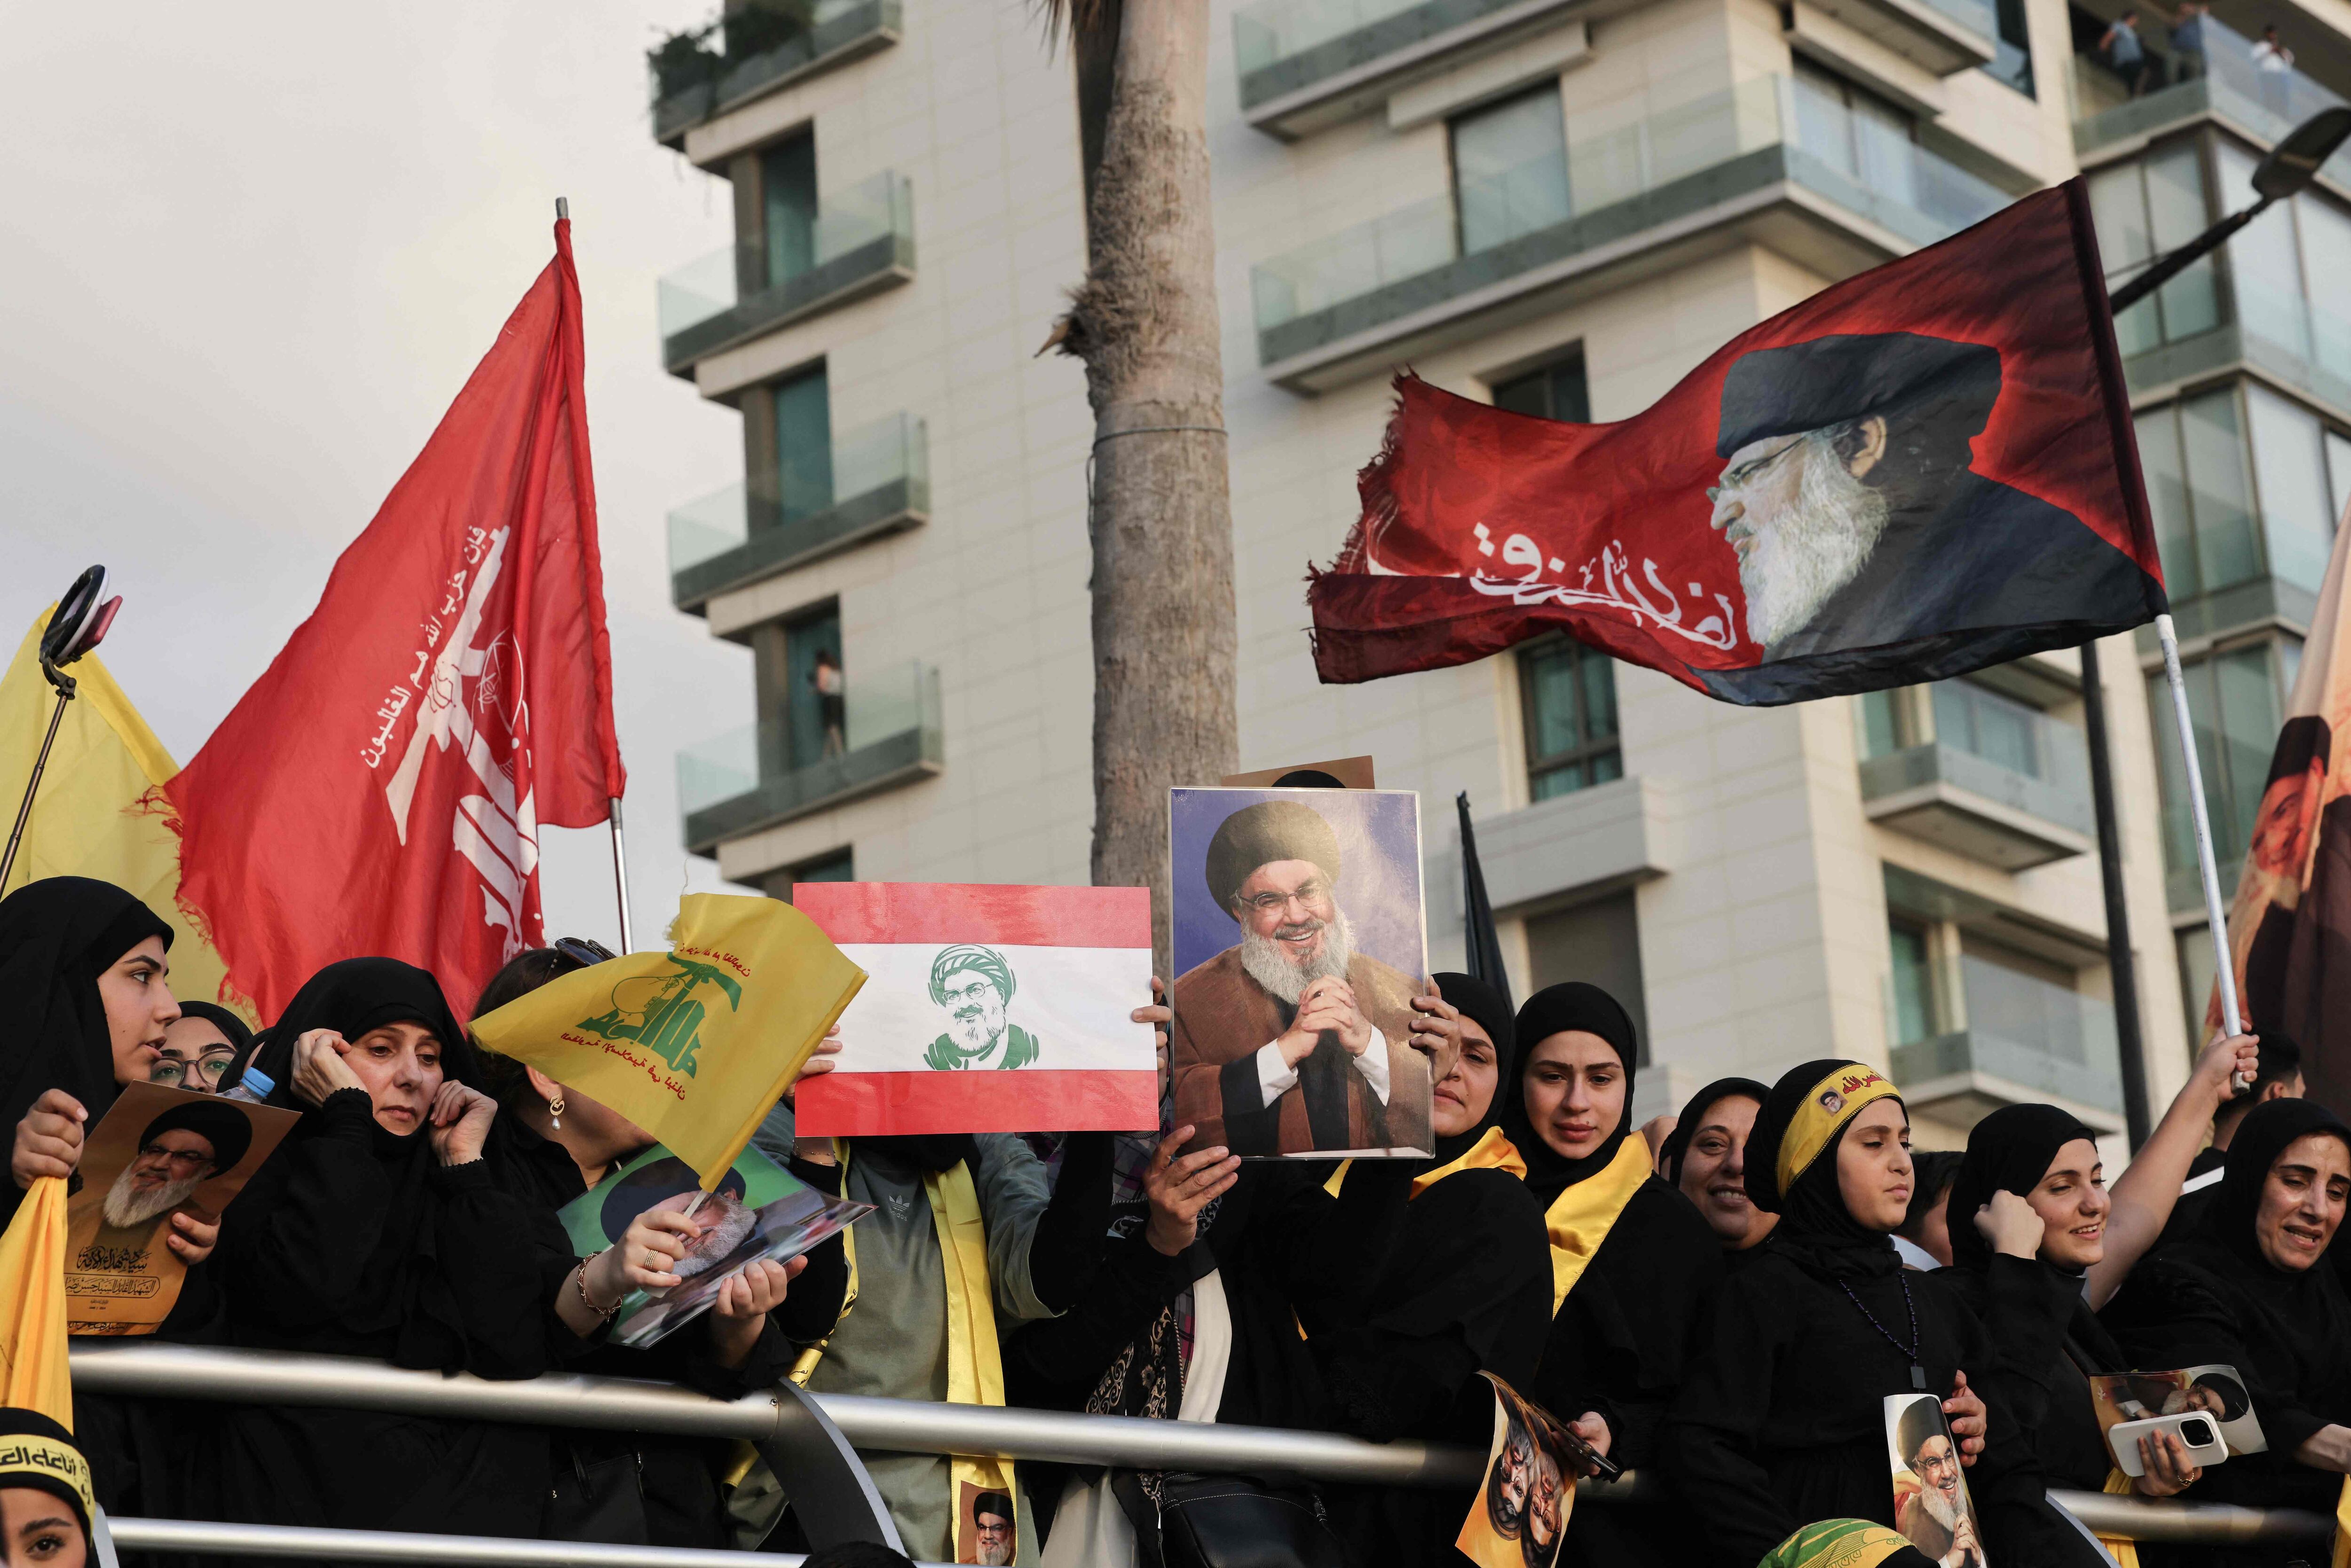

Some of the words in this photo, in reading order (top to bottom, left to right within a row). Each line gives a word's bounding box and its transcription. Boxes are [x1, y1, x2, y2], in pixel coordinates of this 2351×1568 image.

[440, 569, 467, 615] حزب
[420, 615, 443, 648] الله
[410, 651, 430, 690] هم
[360, 685, 412, 769] الغالبون
[0, 1446, 31, 1466] الع
